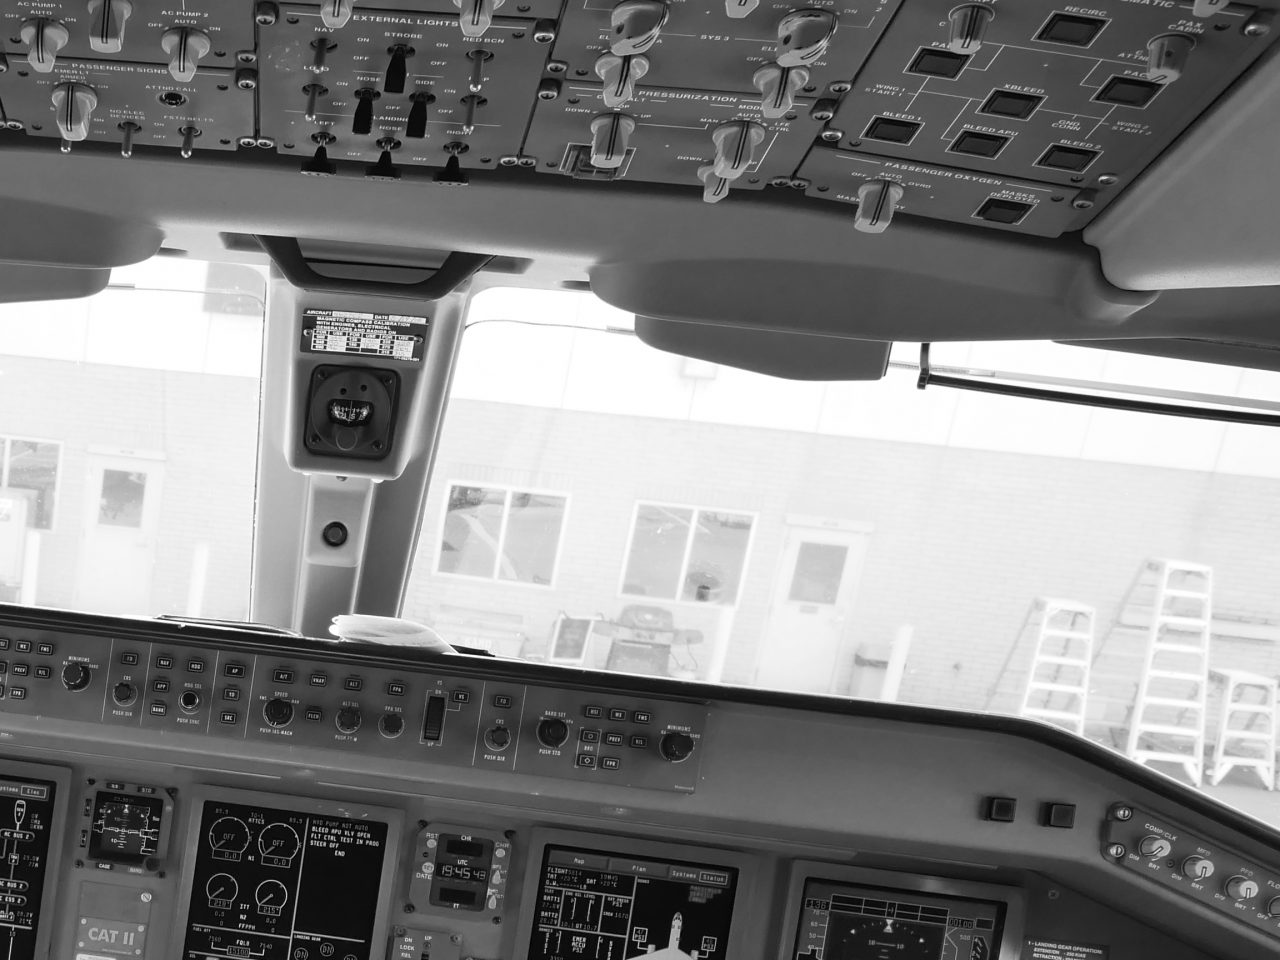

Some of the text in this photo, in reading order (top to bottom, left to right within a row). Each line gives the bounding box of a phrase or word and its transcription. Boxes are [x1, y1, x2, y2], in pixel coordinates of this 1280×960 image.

[1064, 6, 1108, 17] RECIRC
[353, 14, 459, 27] EXTERNAL LIGHTS
[1177, 19, 1203, 28] PAX
[1167, 24, 1205, 34] CABIN
[384, 32, 423, 40] STROBE
[71, 63, 168, 75] PASSENGER SIGNS
[864, 87, 896, 96] START
[875, 83, 900, 91] WING
[1003, 83, 1045, 94] XBLEED
[638, 90, 738, 102] PRESSURIZATION
[882, 111, 916, 120] BLEED
[962, 123, 1019, 136] BLEED APU
[1051, 122, 1081, 131] CONN
[1059, 139, 1094, 148] BLEED
[884, 162, 1003, 186] PASSENGER OXYGEN
[990, 191, 1041, 204] DEPLOYED
[1000, 189, 1036, 199] MASKS
[415, 872, 433, 880] DATE
[87, 926, 135, 946] CAT II
